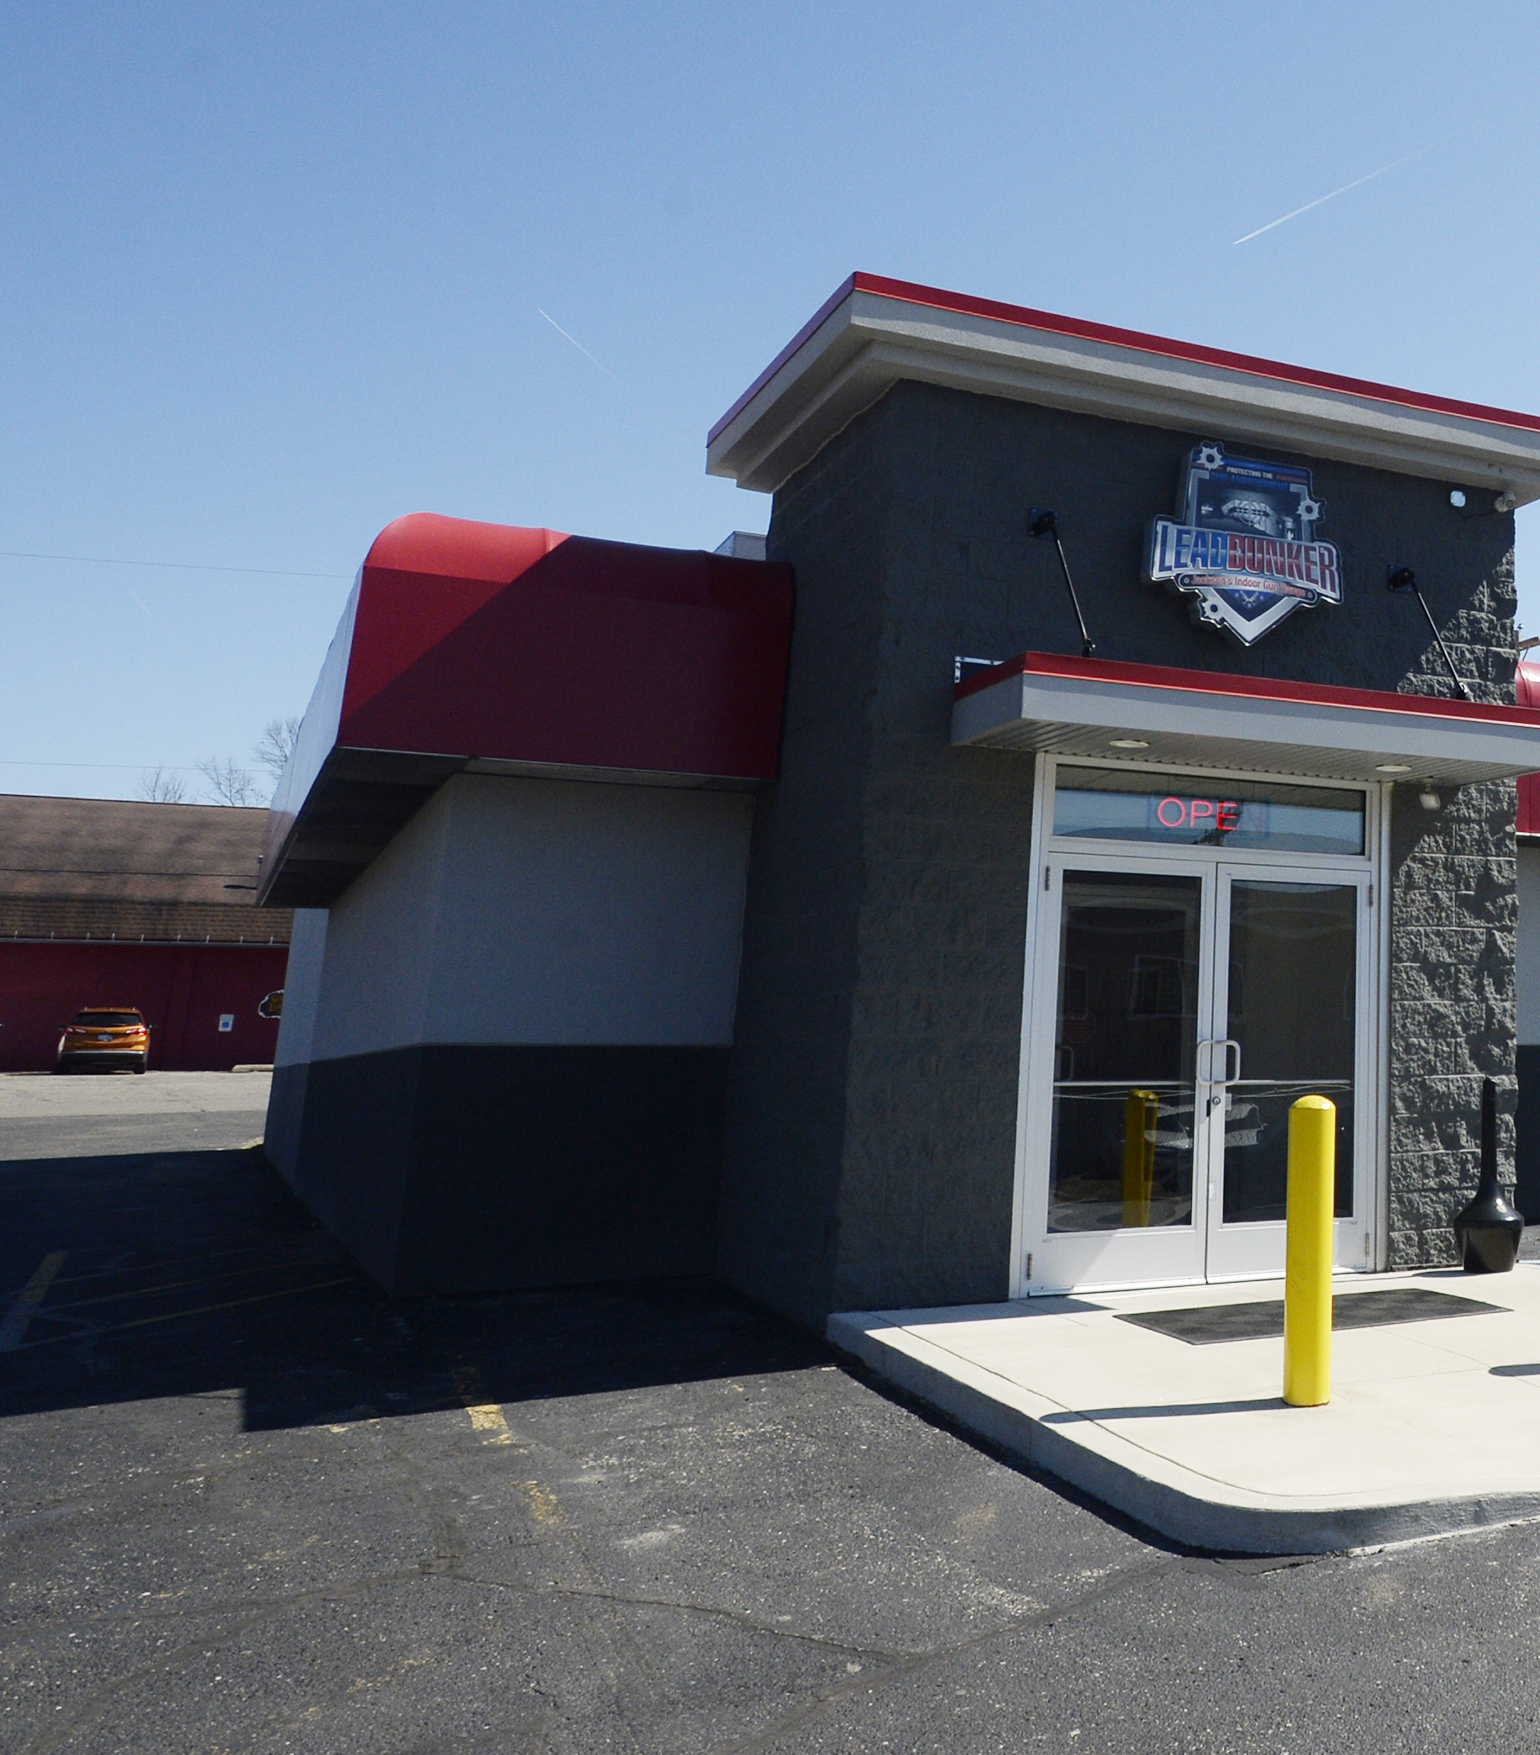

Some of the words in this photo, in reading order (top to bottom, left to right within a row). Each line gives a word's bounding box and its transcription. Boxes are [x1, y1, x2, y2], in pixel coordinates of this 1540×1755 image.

[1262, 471, 1273, 480] THE
[1235, 577, 1261, 588] Indoor
[1263, 579, 1279, 591] Gun
[1157, 796, 1264, 835] OPE
